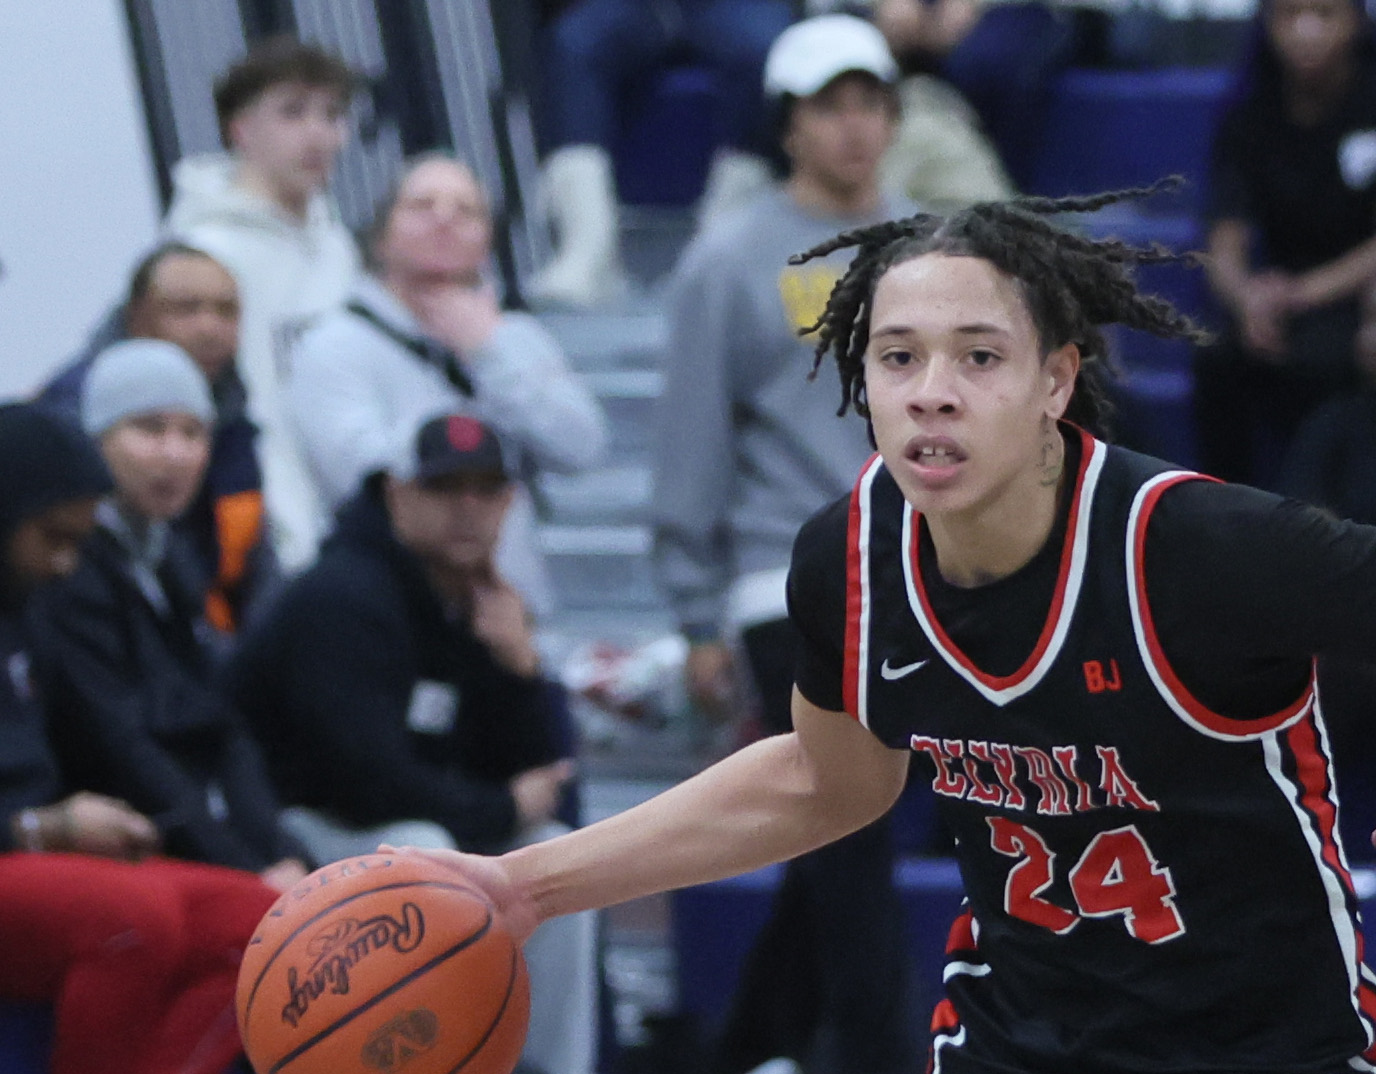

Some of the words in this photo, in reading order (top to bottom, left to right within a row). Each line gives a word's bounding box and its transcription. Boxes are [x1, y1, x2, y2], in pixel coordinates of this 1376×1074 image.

[1083, 658, 1122, 694] BJ
[985, 815, 1186, 945] 24
[281, 904, 426, 1028] Rawlings
